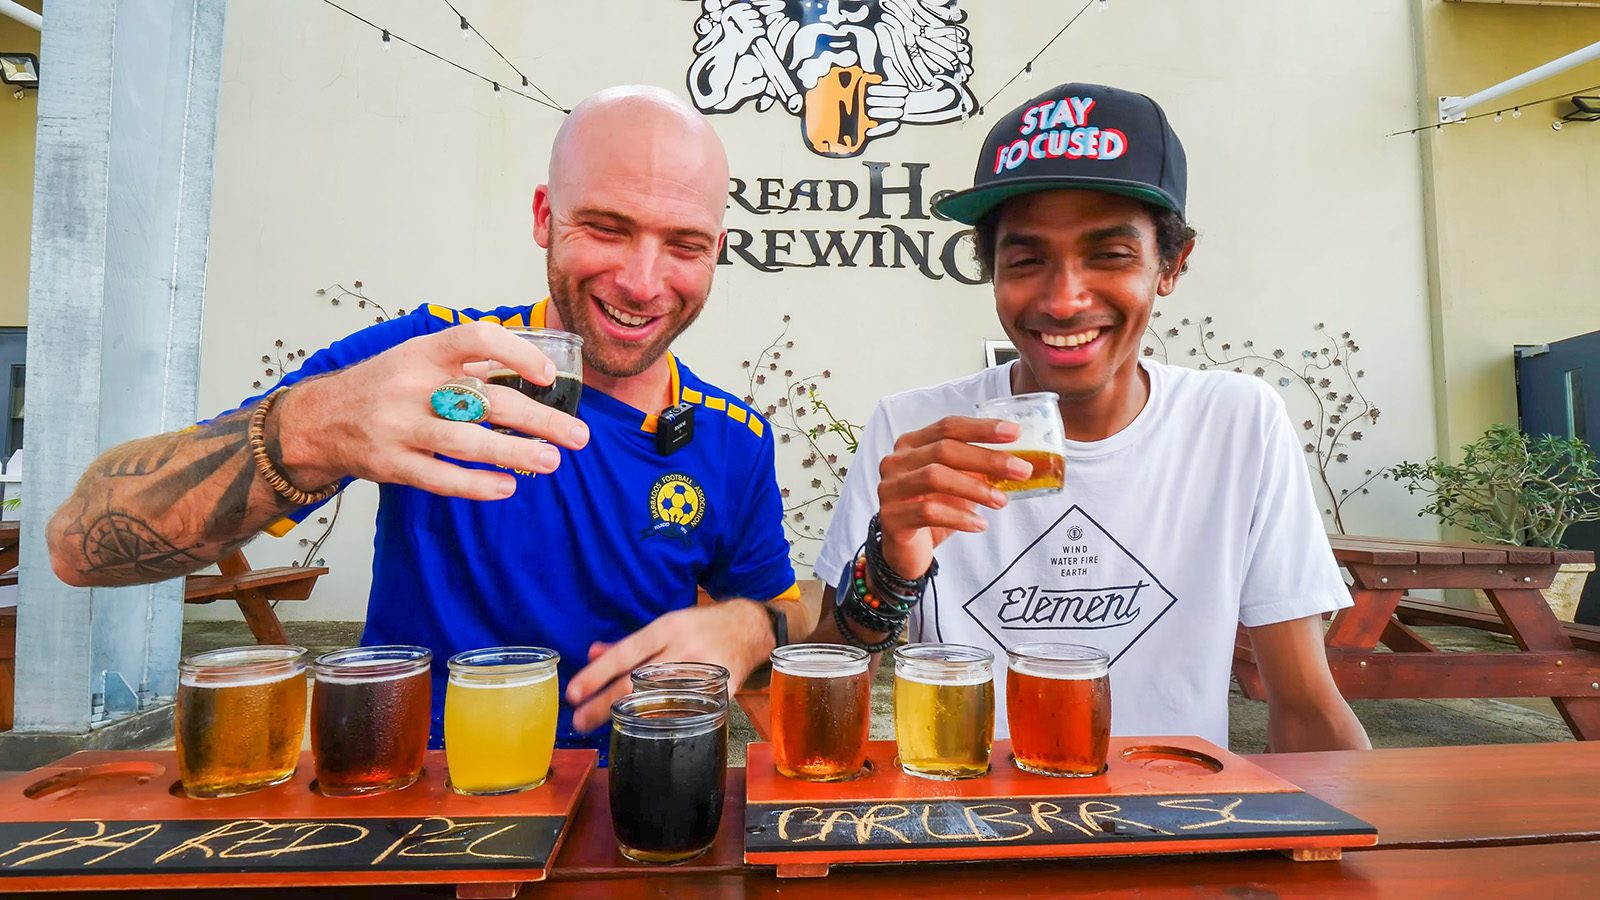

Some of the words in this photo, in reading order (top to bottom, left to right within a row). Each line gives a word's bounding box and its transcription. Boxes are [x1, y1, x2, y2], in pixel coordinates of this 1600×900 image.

[1019, 96, 1096, 135] STAY
[993, 126, 1128, 174] FOCUSED
[726, 177, 859, 214] READ
[650, 482, 662, 519] BARBADOS
[661, 474, 693, 486] FOOTBALL
[690, 486, 706, 528] ASSOCIATION
[1050, 557, 1078, 565] WATER
[1080, 556, 1099, 564] FIRE
[1062, 545, 1088, 553] WIND
[1060, 568, 1088, 577] EARTH
[998, 580, 1148, 628] Element
[155, 820, 370, 864] RED
